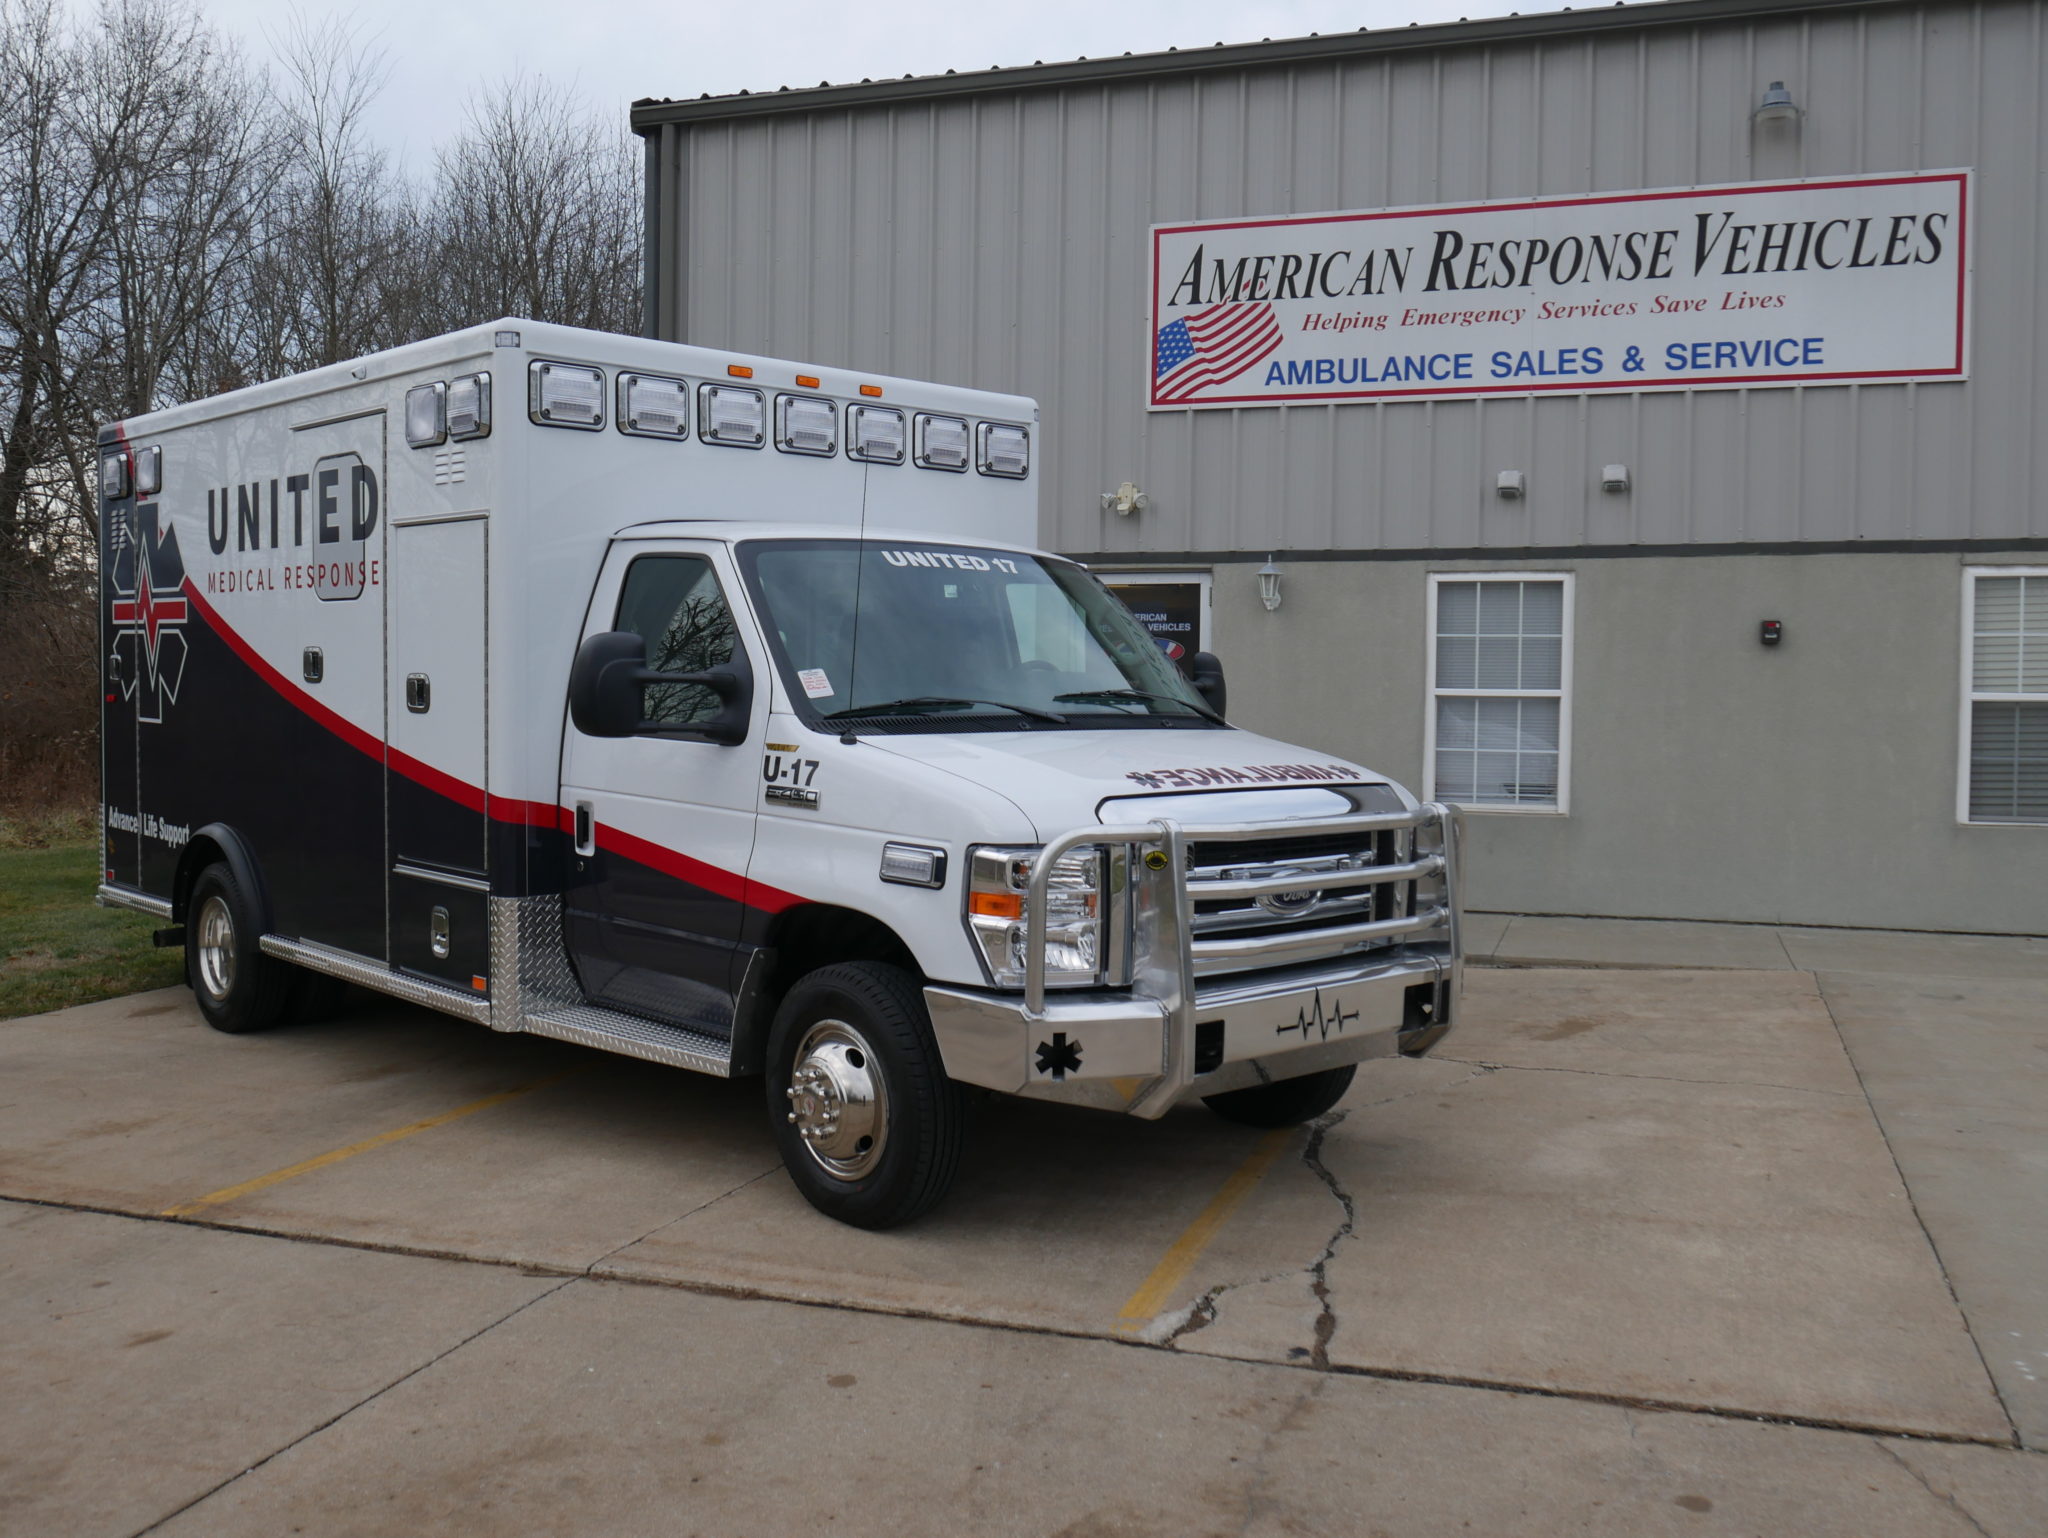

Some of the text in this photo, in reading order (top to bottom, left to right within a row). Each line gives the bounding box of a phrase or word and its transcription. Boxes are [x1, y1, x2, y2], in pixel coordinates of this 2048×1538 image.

[1167, 212, 1949, 306] AMERICAN RESPONSE VEHICLES
[1302, 291, 1787, 334] Helping Emergency Services Save Lives
[1264, 337, 1825, 386] AMBULANCE SALES & SERVICE
[207, 464, 379, 555] UNITED
[208, 560, 379, 594] MEDICAL RESPONSE
[881, 550, 1018, 575] UNITED 17
[1134, 612, 1168, 622] ERICAN
[1147, 622, 1191, 632] VEHICLES
[763, 754, 820, 787] U-17
[143, 812, 158, 839] Life
[159, 817, 190, 849] Support
